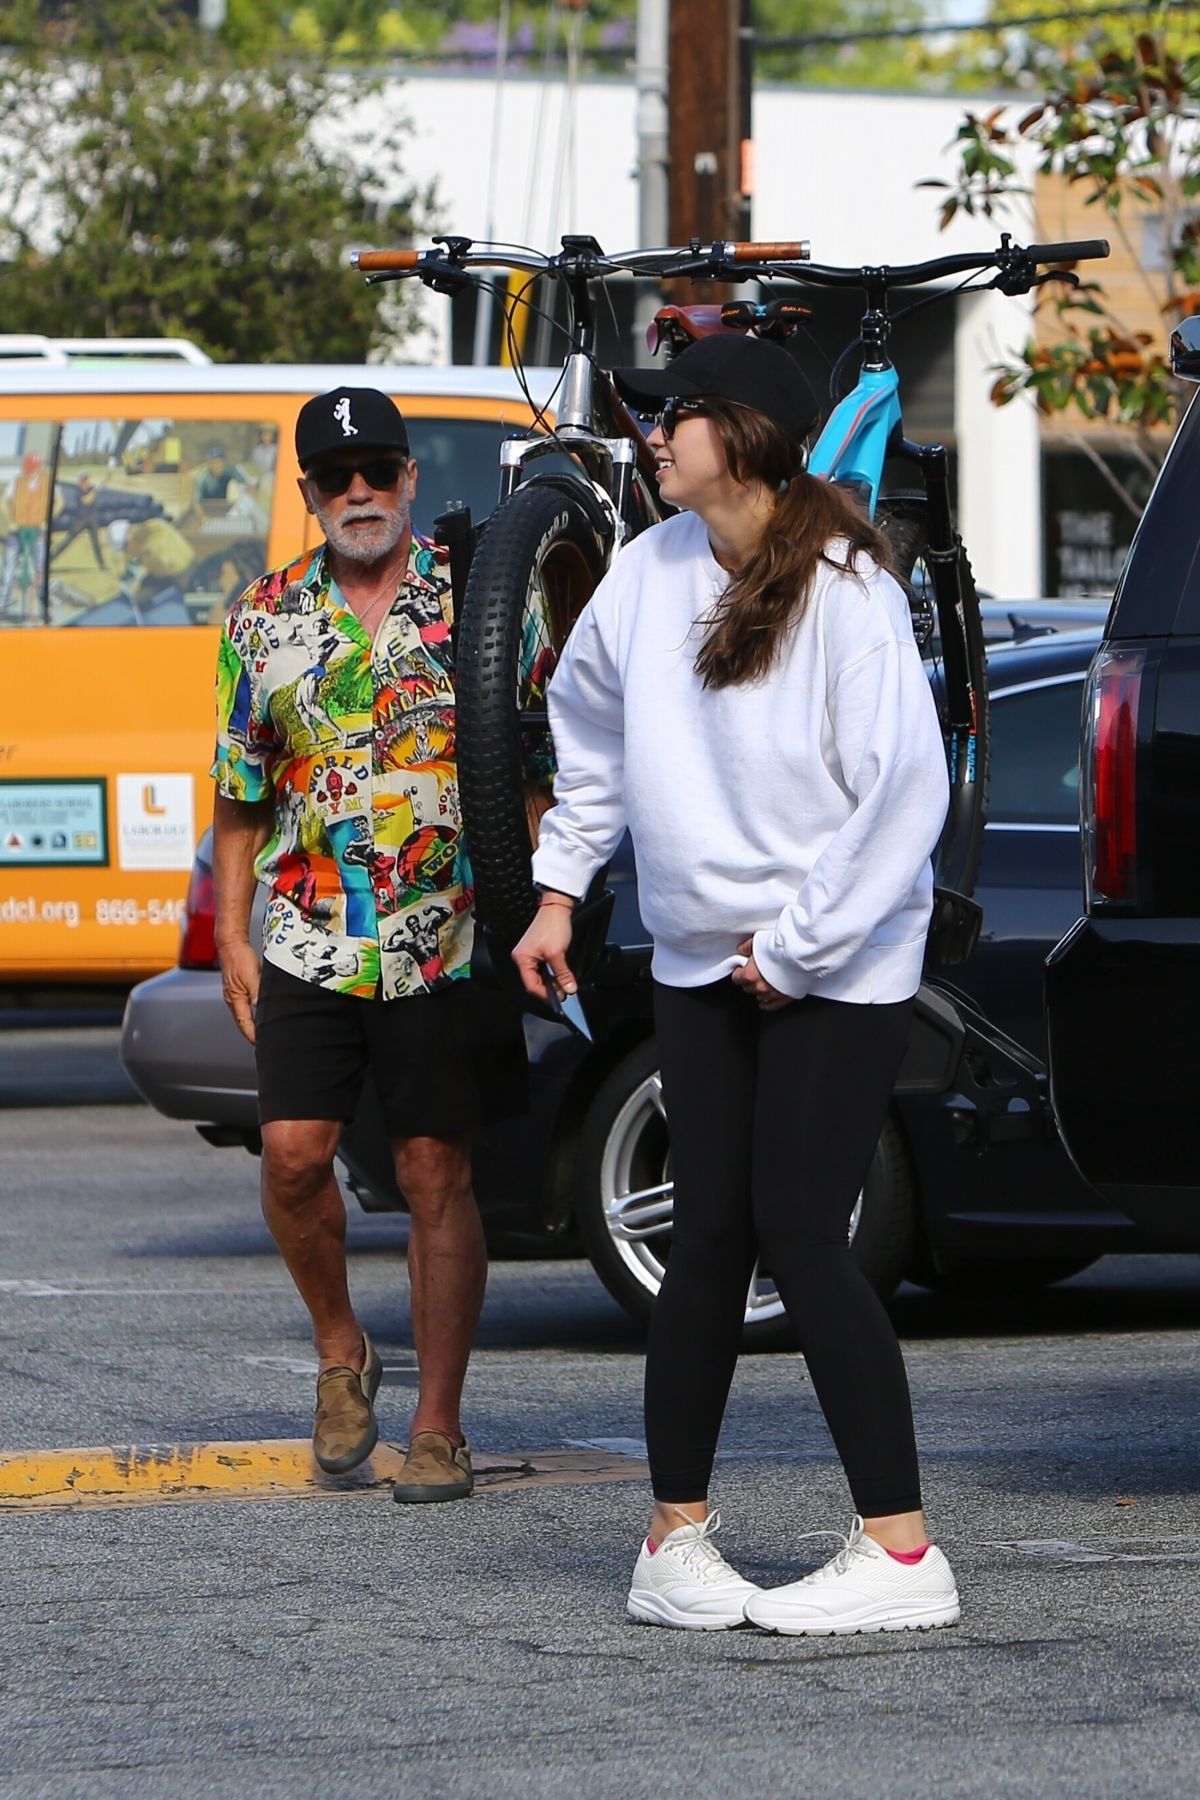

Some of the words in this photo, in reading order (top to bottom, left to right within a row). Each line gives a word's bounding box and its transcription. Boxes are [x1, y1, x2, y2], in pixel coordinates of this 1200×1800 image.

[234, 616, 280, 649] WORLD
[309, 756, 369, 792] WORLD
[317, 798, 363, 818] GYM
[0, 896, 79, 920] dcl.org
